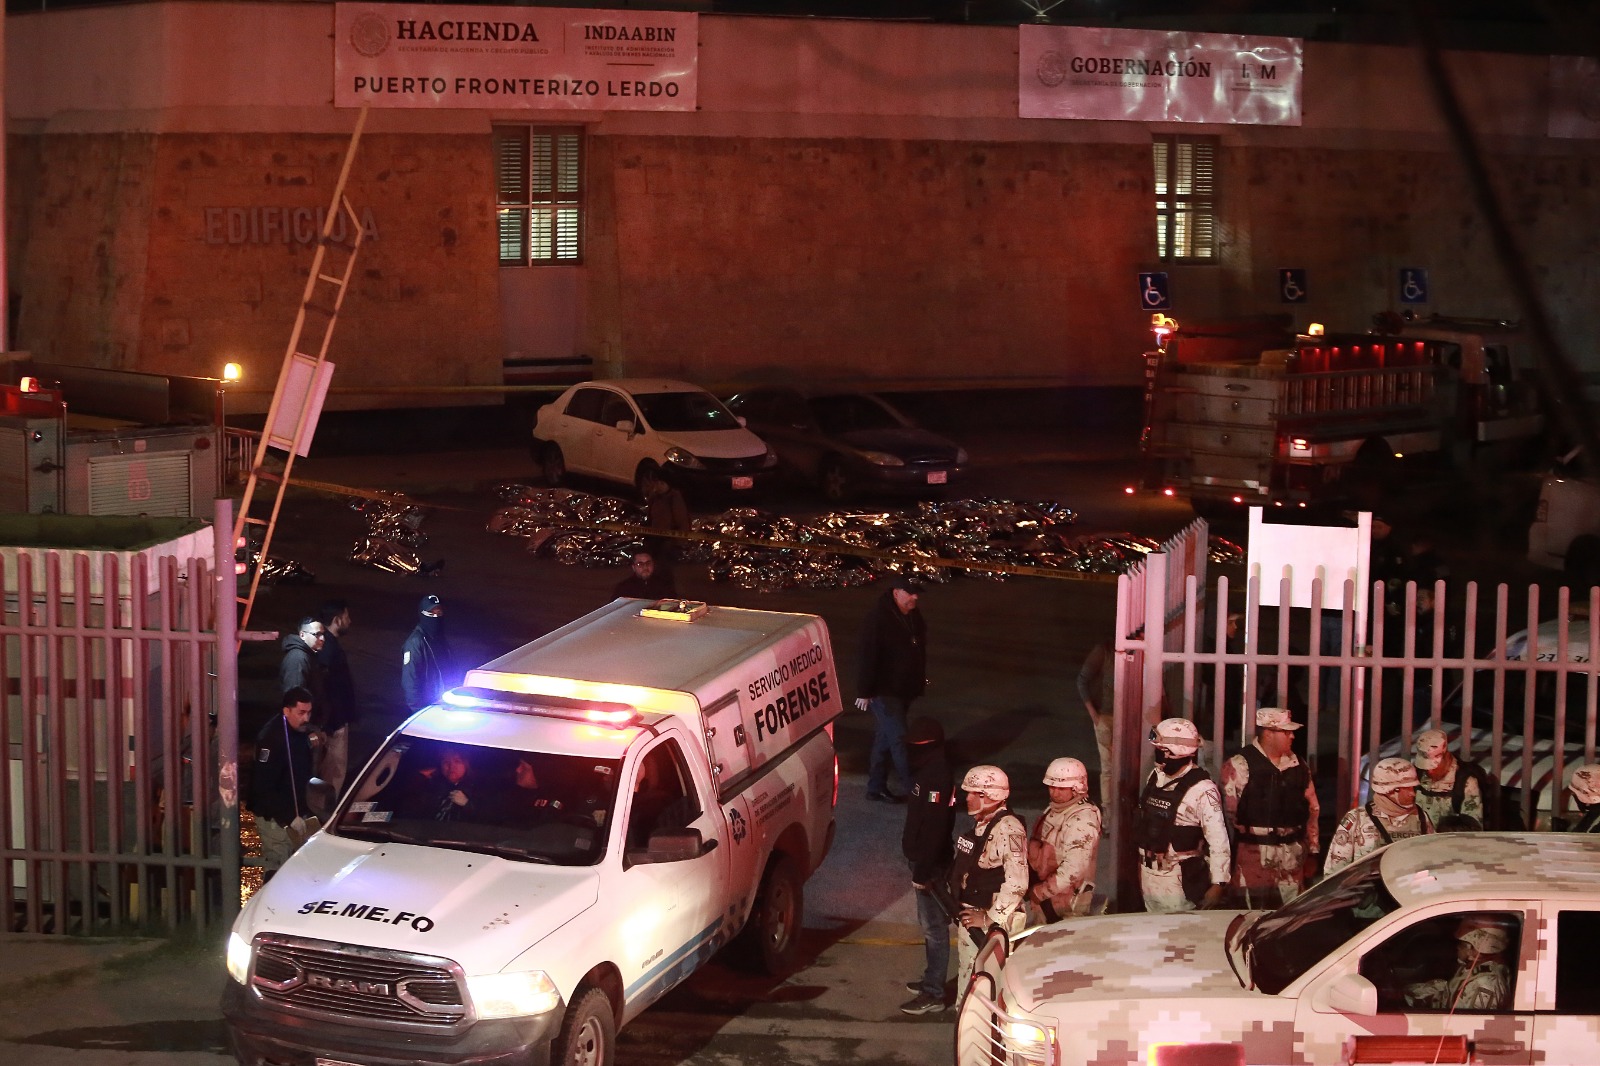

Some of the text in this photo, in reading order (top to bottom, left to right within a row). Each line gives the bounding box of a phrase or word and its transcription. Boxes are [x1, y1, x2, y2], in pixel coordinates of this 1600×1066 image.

[396, 20, 540, 42] HACIENDA
[584, 25, 676, 42] INDAABIN
[1071, 56, 1212, 78] GOBERNACIÓN
[1242, 63, 1276, 79] IM
[353, 76, 680, 98] PUERTO FRONTERIZO LERDO
[205, 206, 380, 244] EDIFICIO A
[748, 645, 823, 701] SERVICIO MEDICO
[753, 671, 831, 742] FORENSE
[297, 900, 435, 933] SE.ME.FO
[307, 972, 389, 996] RAM
